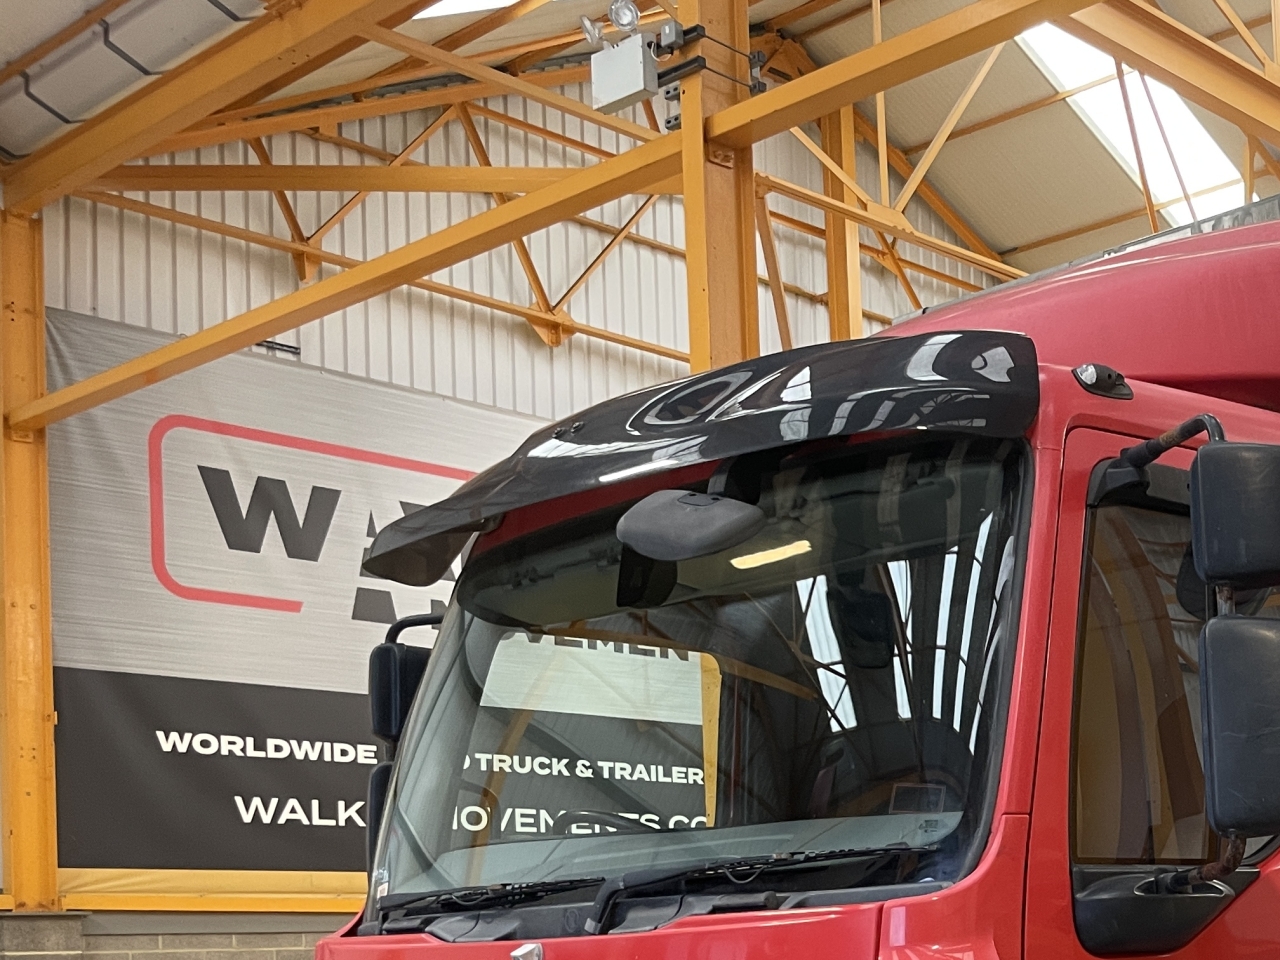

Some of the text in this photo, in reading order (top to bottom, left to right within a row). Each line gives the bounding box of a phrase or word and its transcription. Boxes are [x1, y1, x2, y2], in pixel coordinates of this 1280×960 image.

[156, 730, 378, 764] WORLDWIDE
[474, 753, 570, 777] TRUCK
[575, 760, 594, 778] &
[597, 761, 704, 784] TRAILER
